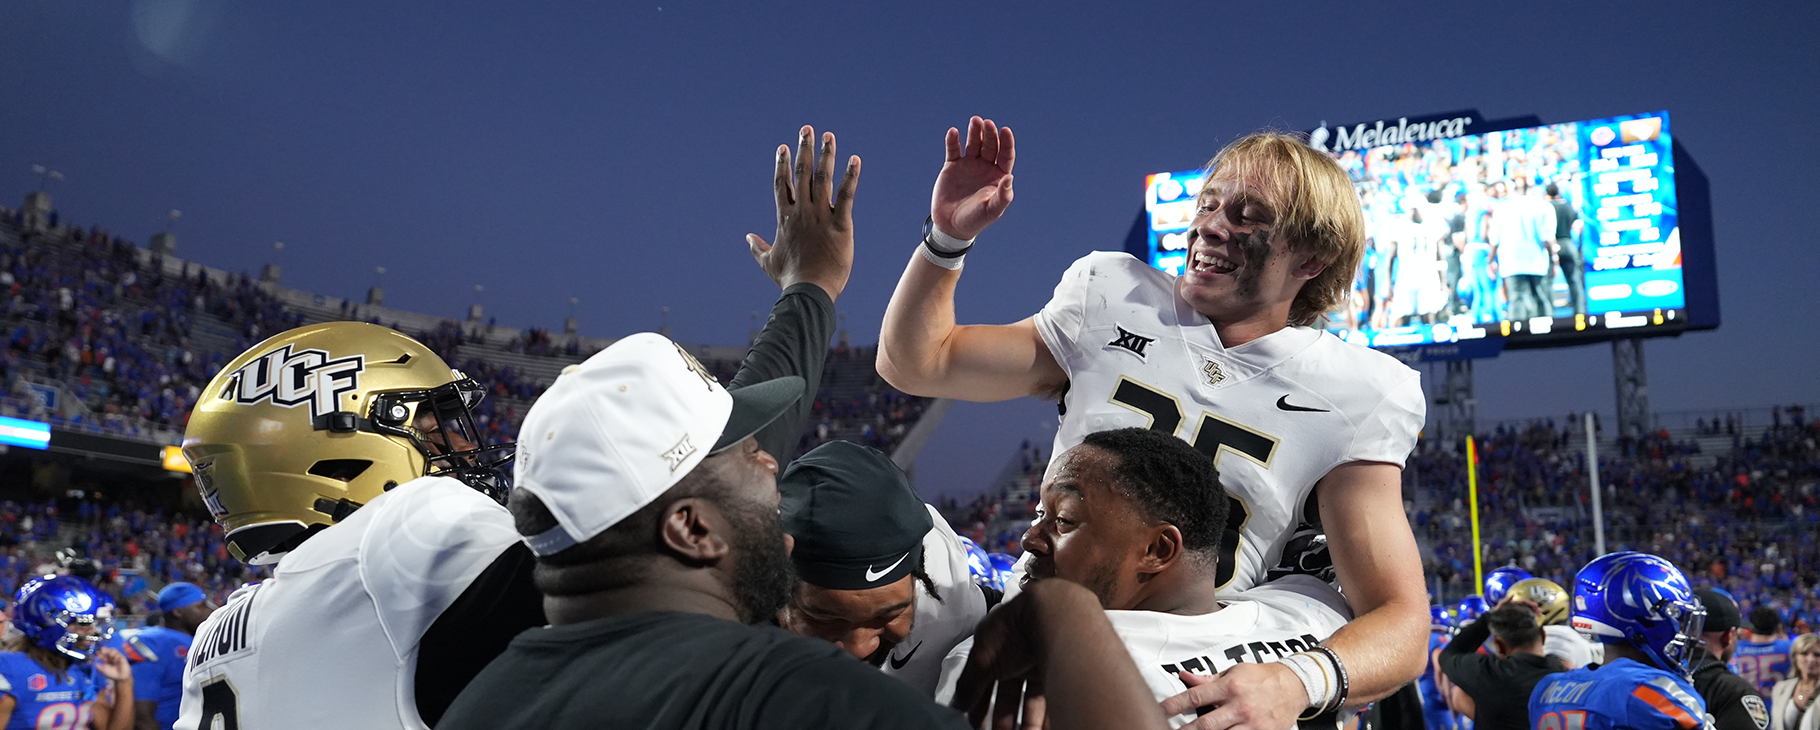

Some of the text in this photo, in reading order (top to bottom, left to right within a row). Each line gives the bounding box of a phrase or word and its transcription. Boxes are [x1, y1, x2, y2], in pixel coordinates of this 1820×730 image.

[1333, 116, 1466, 151] Melaleuca
[1107, 325, 1156, 359] XII
[224, 343, 366, 425] UCF
[1203, 358, 1227, 385] UCF
[659, 433, 697, 476] XII
[206, 488, 230, 516] II
